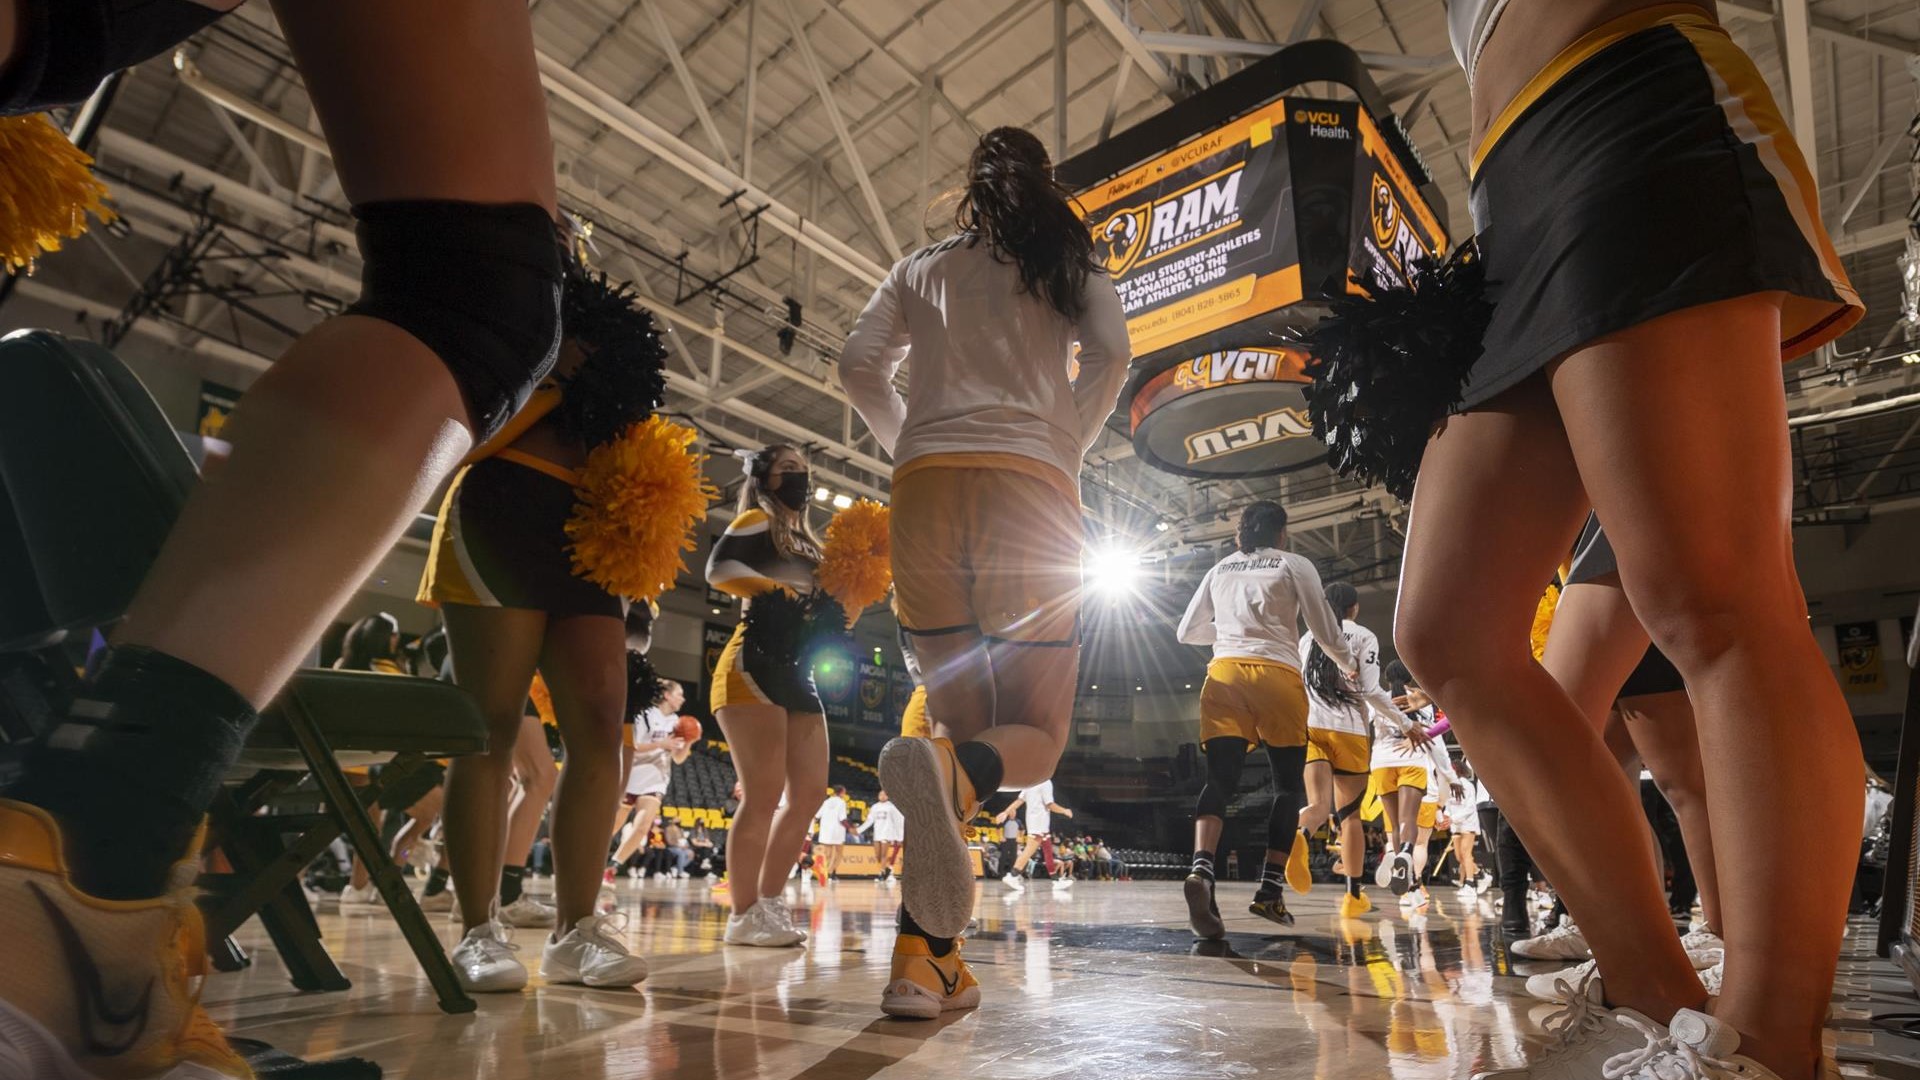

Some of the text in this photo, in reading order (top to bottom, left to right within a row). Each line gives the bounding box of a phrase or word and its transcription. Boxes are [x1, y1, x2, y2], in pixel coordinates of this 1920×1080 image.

[1307, 111, 1340, 125] VCU
[1310, 124, 1350, 140] Health
[1171, 136, 1223, 169] @VCURAF
[1150, 170, 1243, 247] RAM
[1145, 213, 1239, 258] ATHLETIC FUND
[1134, 271, 1156, 287] VCU
[1158, 228, 1262, 278] STUDENT-ATHLETES
[1129, 270, 1187, 301] DONATING
[1189, 262, 1205, 277] TO
[1208, 253, 1229, 270] THE
[1146, 278, 1193, 305] ATHLETIC
[1195, 266, 1227, 286] FUND
[1129, 316, 1168, 335] @vcu.edu
[1210, 350, 1280, 383] VCU
[1192, 412, 1314, 458] VCU
[860, 663, 886, 678] NCAA
